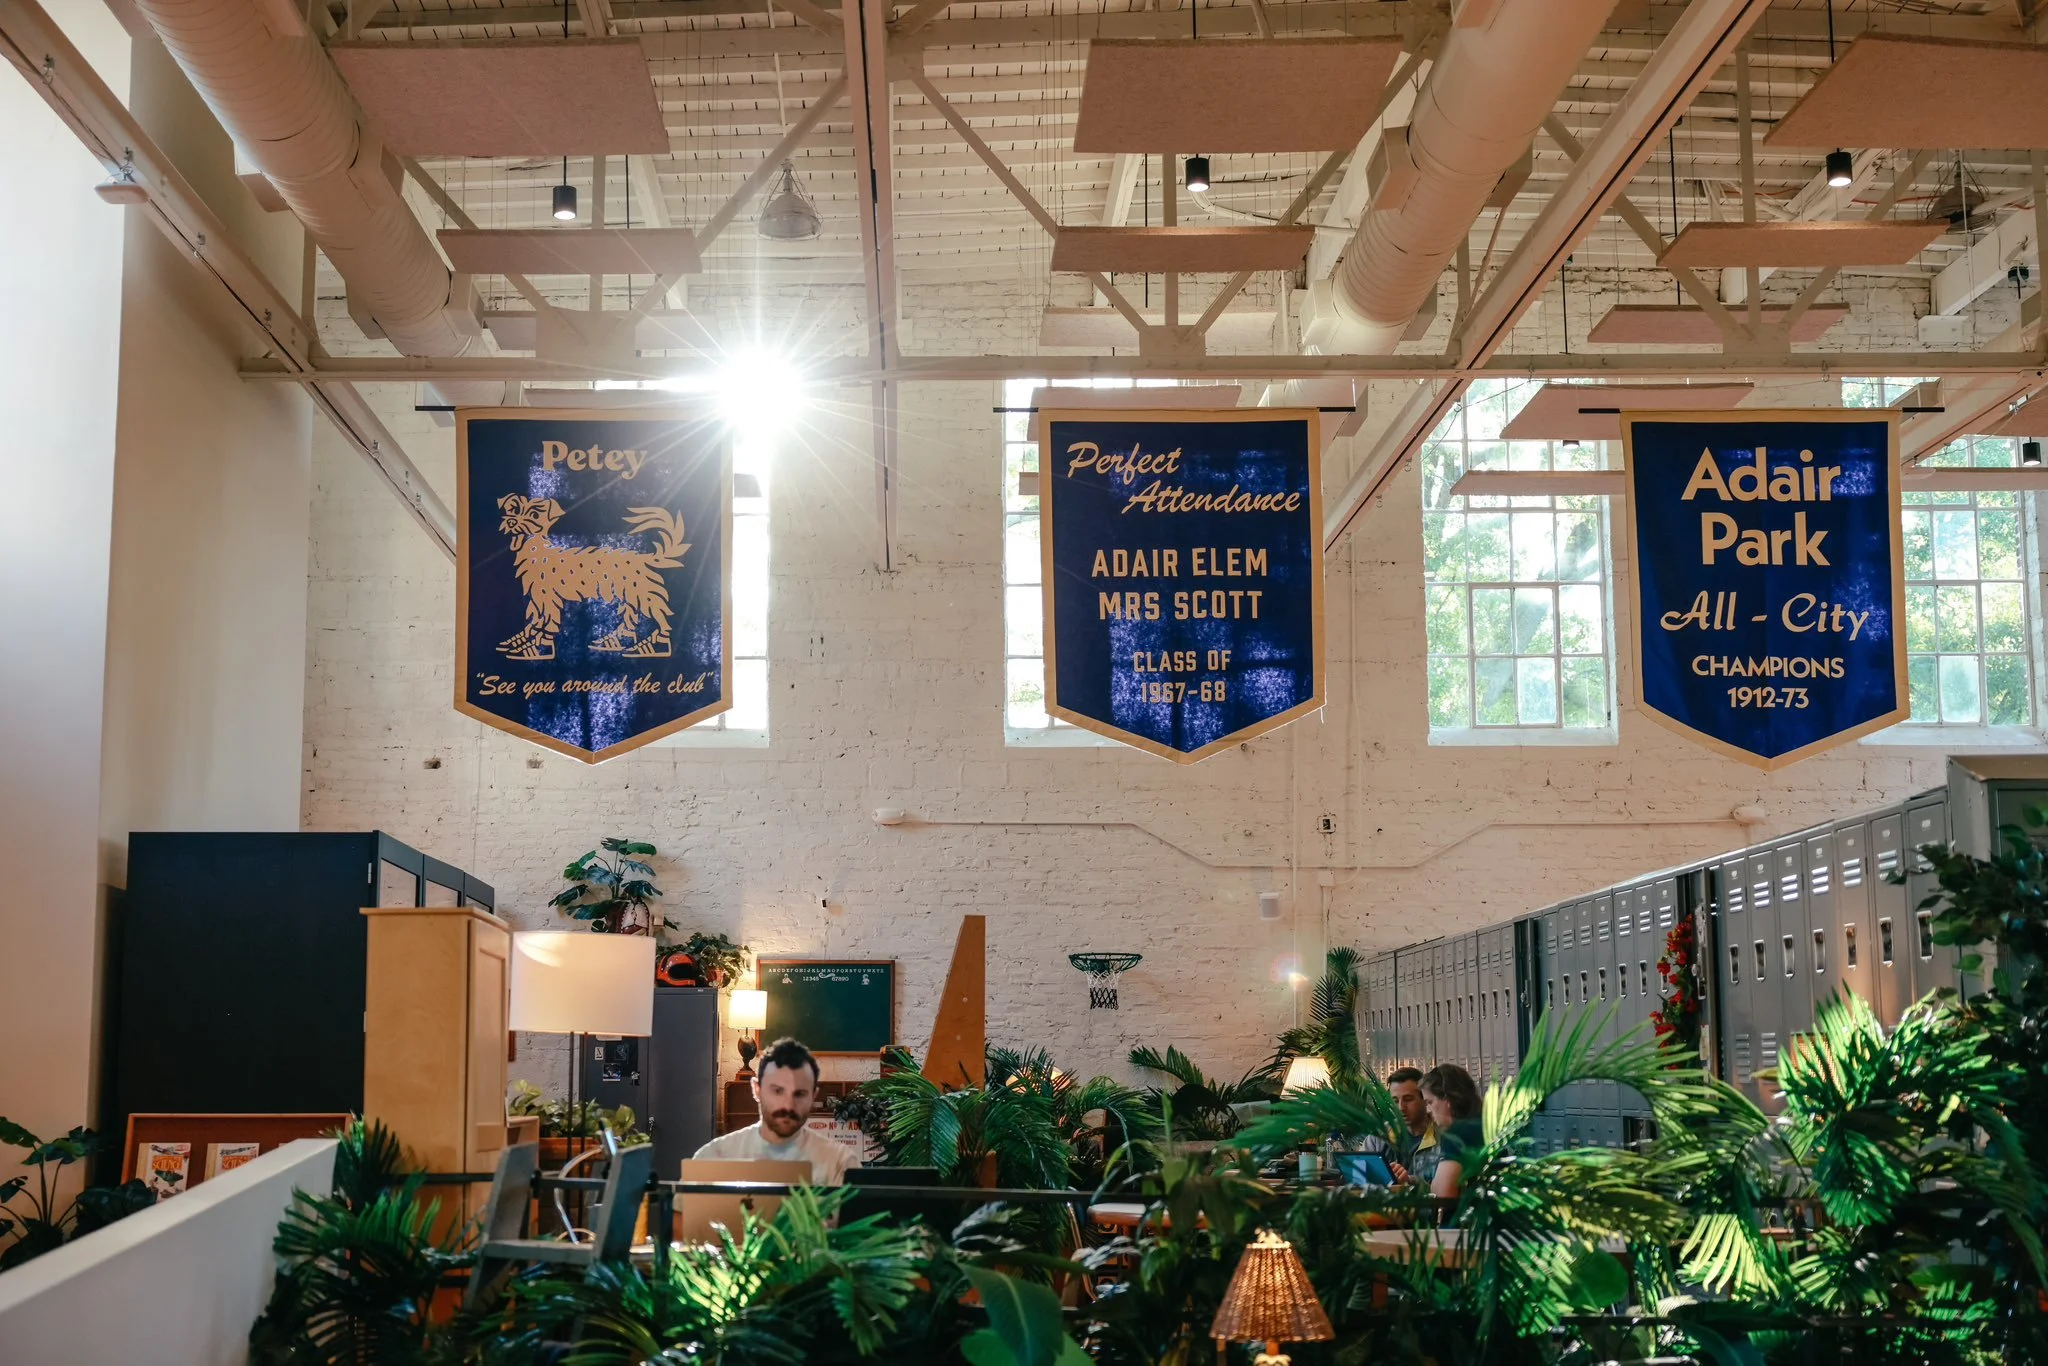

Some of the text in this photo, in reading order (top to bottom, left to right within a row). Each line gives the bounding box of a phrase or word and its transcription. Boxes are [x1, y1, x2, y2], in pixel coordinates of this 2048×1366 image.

[542, 440, 647, 480] Petey
[1067, 441, 1182, 484] Perfect
[1680, 446, 1841, 502] Adair
[1122, 480, 1301, 514] Attendance
[1701, 511, 1831, 566] Park
[1091, 547, 1267, 577] ADAIR ELEM
[1098, 590, 1263, 620] MRS SCOTT
[1660, 590, 1737, 631] All
[1781, 592, 1869, 641] City
[1133, 649, 1232, 673] CLASS OF
[1691, 654, 1845, 679] CHAMPIONS
[523, 680, 556, 699] you
[561, 676, 625, 694] around
[631, 672, 662, 693] the
[1141, 681, 1227, 703] 1967-68
[1727, 686, 1810, 709] 1912-73
